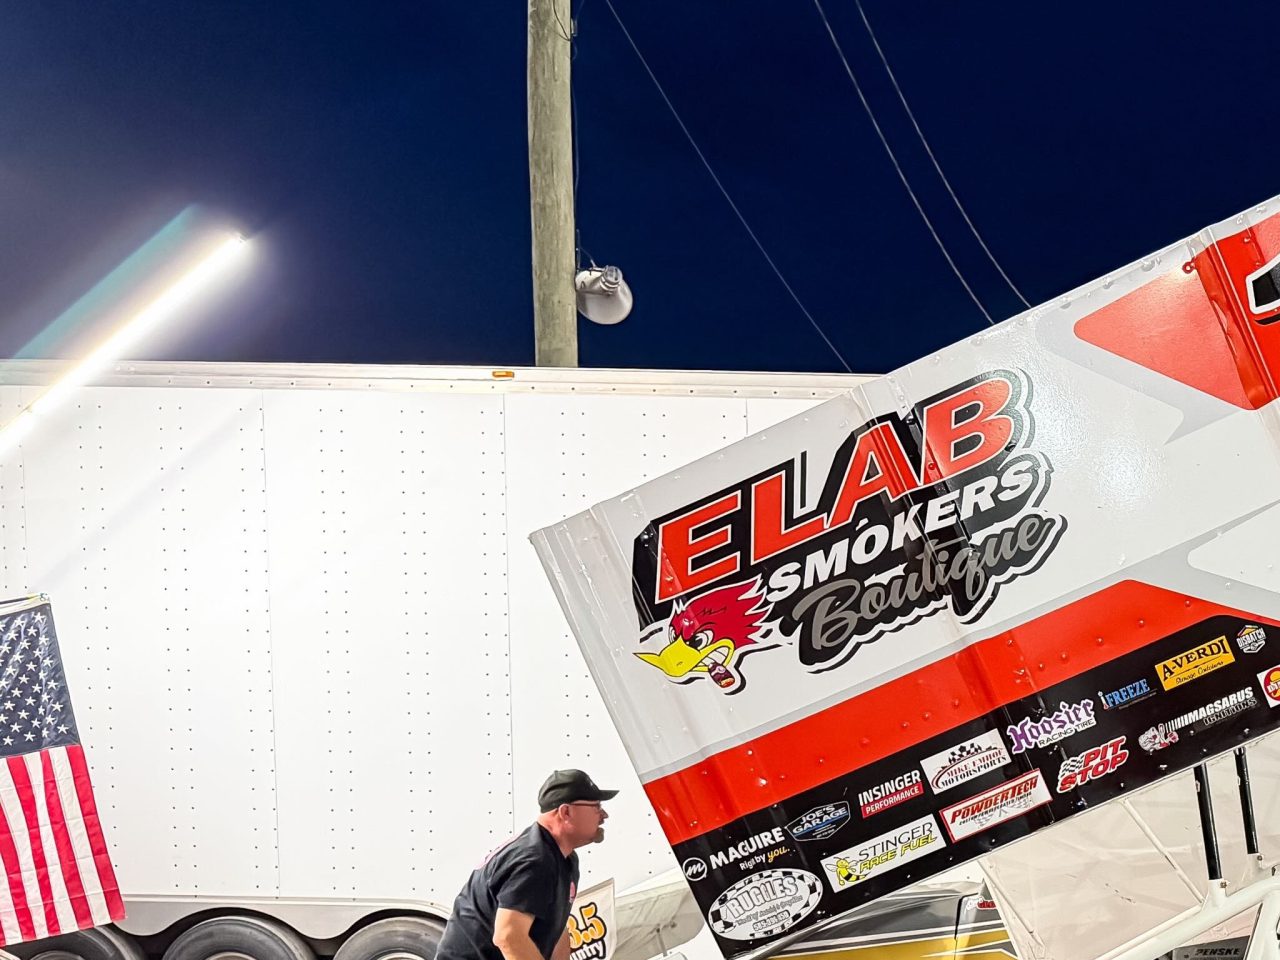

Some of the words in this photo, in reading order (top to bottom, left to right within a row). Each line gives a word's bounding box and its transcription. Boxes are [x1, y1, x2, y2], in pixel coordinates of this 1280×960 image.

[654, 375, 1019, 603] ELAB
[763, 457, 1042, 603] SMOKERS
[791, 514, 1054, 650] Boutique
[1161, 638, 1230, 681] A-VERDI
[1007, 699, 1094, 754] Hoosier
[1038, 726, 1075, 748] RACING
[1074, 718, 1096, 735] TIRE
[941, 756, 1008, 787] MOTORSPORTS
[946, 761, 971, 779] MIKE
[1058, 750, 1128, 793] STOP
[1082, 736, 1126, 768] PIT
[858, 769, 922, 806] INSINGER
[865, 785, 920, 815] PERFORMANCE
[792, 806, 848, 835] GARAGE
[800, 804, 836, 825] JOE'S
[709, 826, 786, 870] MAGUIRE
[858, 821, 934, 862] STINGER
[859, 850, 897, 874] RACE
[899, 831, 939, 858] FUEL
[1194, 947, 1241, 957] PENSKE
